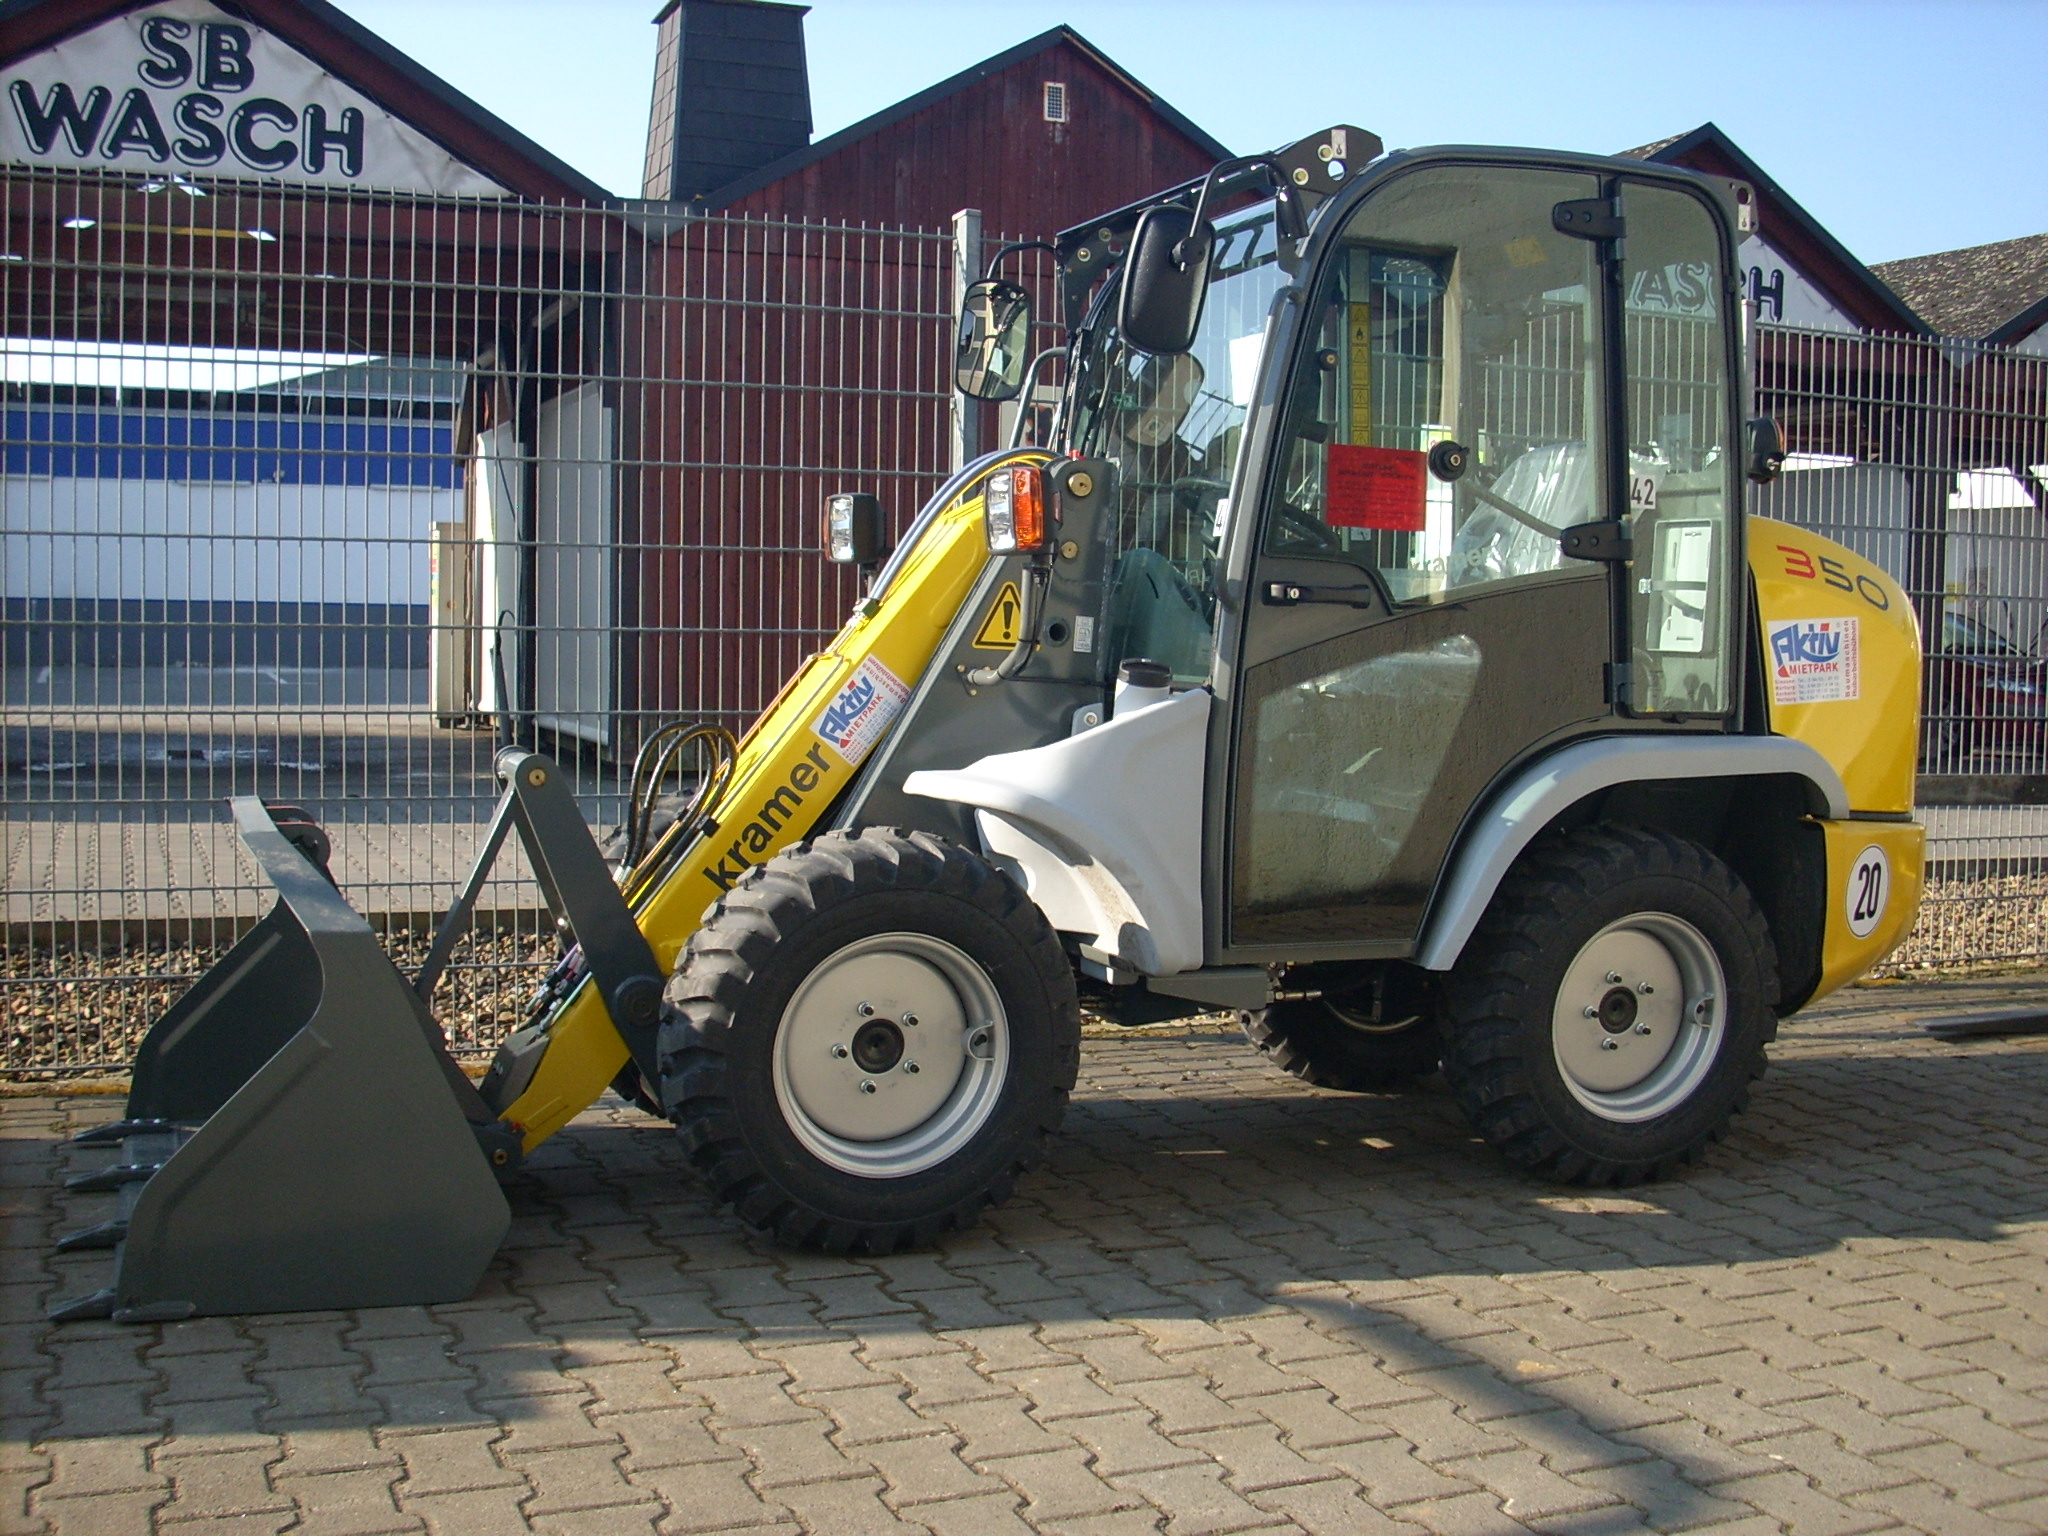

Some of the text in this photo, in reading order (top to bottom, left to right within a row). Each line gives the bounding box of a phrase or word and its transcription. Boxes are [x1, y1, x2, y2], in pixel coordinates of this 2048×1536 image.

[138, 17, 255, 93] SB
[9, 79, 365, 178] WASCH
[1631, 478, 1654, 506] 42
[1776, 545, 1889, 611] 350
[1789, 662, 1839, 675] MIETPARK
[845, 693, 884, 738] MIETPARK
[702, 742, 831, 893] kramer
[1853, 862, 1882, 921] 20
